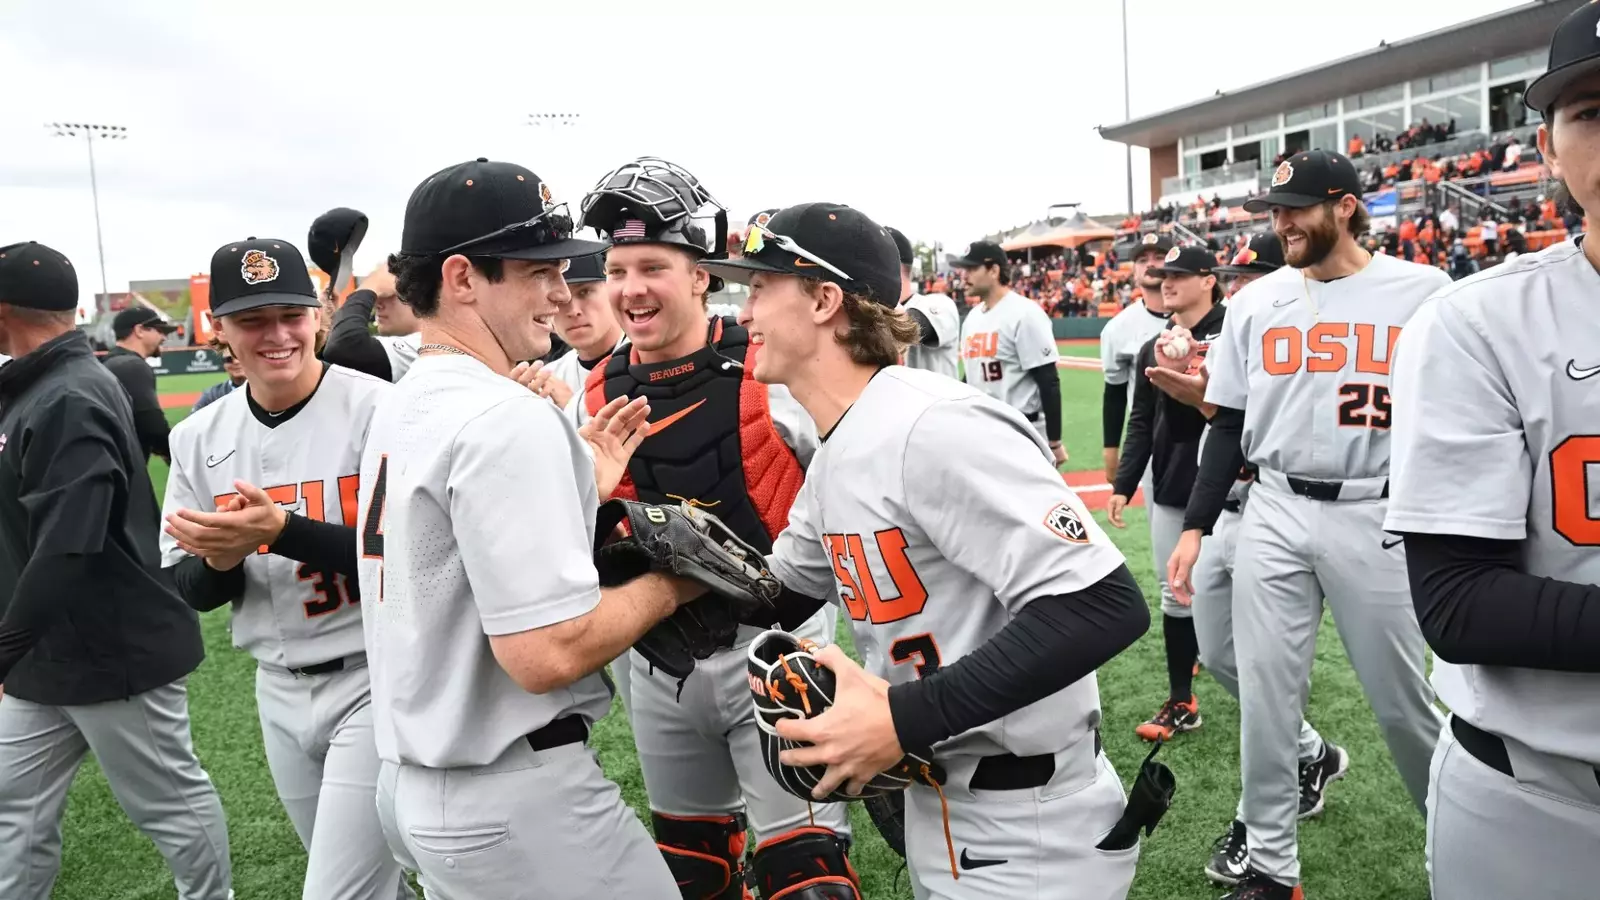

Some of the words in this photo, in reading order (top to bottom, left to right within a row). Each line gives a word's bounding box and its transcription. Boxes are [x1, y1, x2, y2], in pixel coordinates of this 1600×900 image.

[1262, 322, 1403, 376] OSU
[649, 362, 695, 381] BEAVERS
[981, 361, 1003, 382] 19
[822, 526, 929, 625] SU
